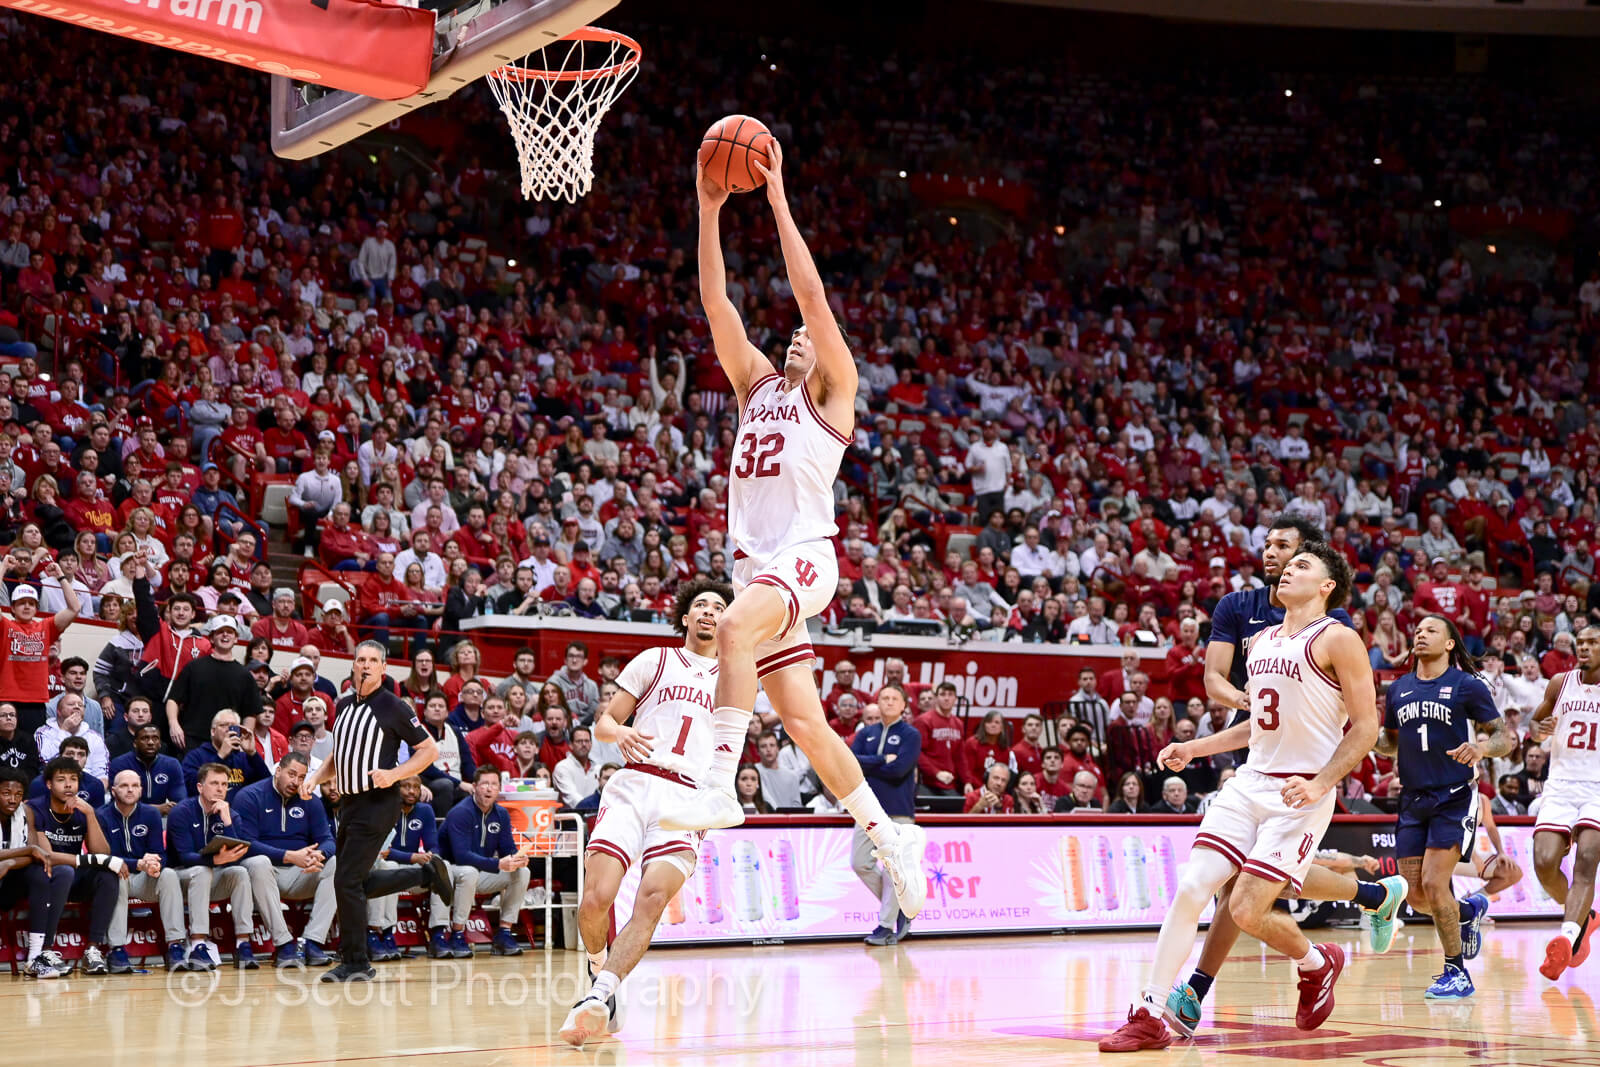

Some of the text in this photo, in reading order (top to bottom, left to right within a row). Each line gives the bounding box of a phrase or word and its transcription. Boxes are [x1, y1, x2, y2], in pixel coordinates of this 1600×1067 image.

[743, 404, 800, 424] INANA
[735, 433, 785, 478] 32
[1248, 658, 1303, 683] NDIANA
[657, 685, 715, 714] INDIAN
[1257, 687, 1280, 731] 3
[1562, 700, 1600, 715] INDIA
[1397, 700, 1452, 727] PENN STATE
[671, 715, 693, 756] 1
[1416, 723, 1429, 752] 1
[1567, 720, 1598, 751] 21
[1372, 833, 1396, 847] PSU
[1378, 856, 1396, 875] 10
[945, 909, 986, 919] VODKA
[989, 906, 1031, 917] WATER
